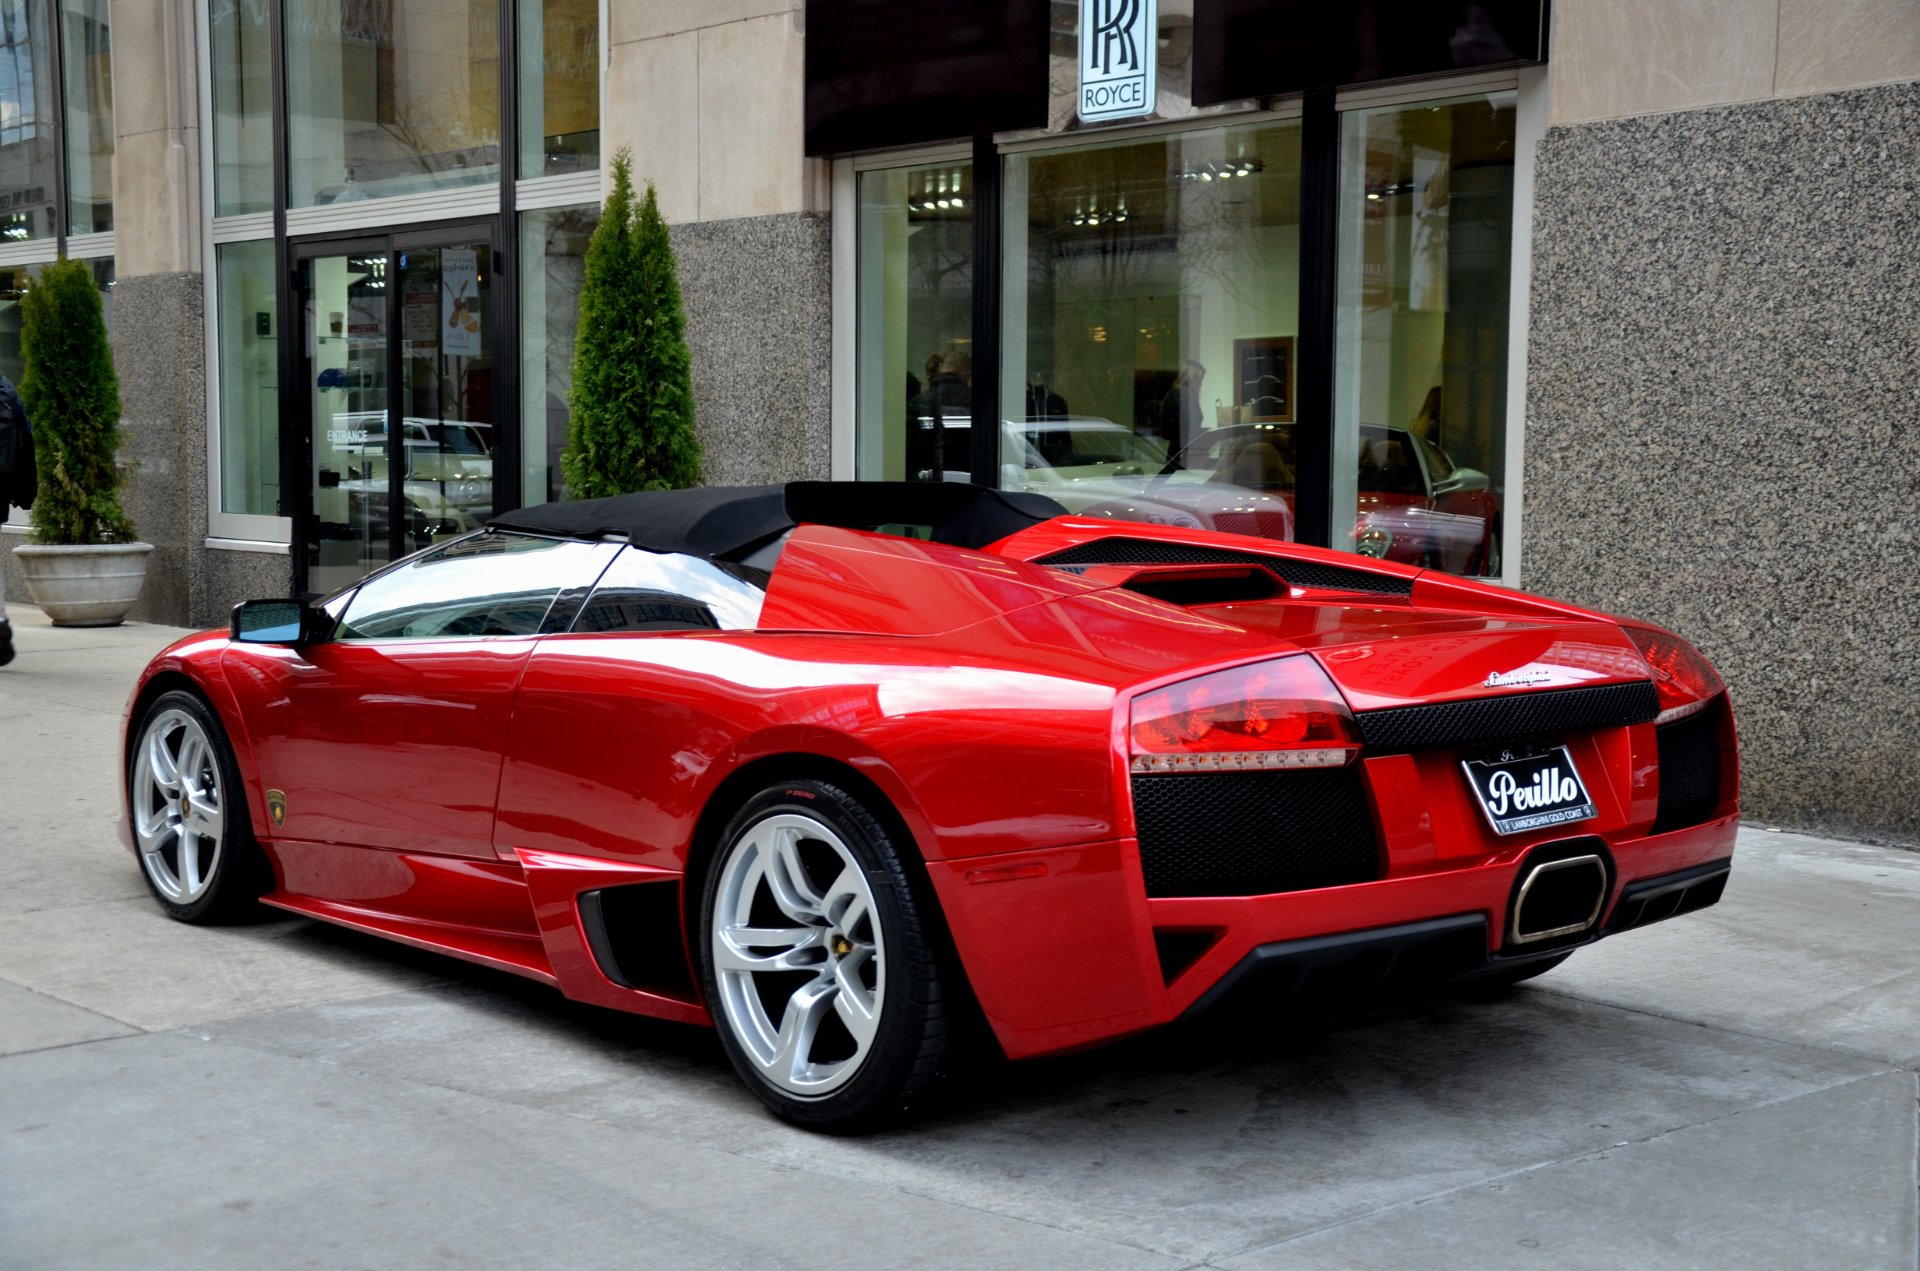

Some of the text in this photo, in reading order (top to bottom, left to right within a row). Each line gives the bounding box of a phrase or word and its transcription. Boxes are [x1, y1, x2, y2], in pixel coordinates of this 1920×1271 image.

[1085, 82, 1141, 108] ROYCE
[327, 430, 368, 442] ENTRANCE
[1488, 767, 1578, 815] Perillo
[1511, 808, 1583, 830] LAMBORGHINI GOLD COAST
